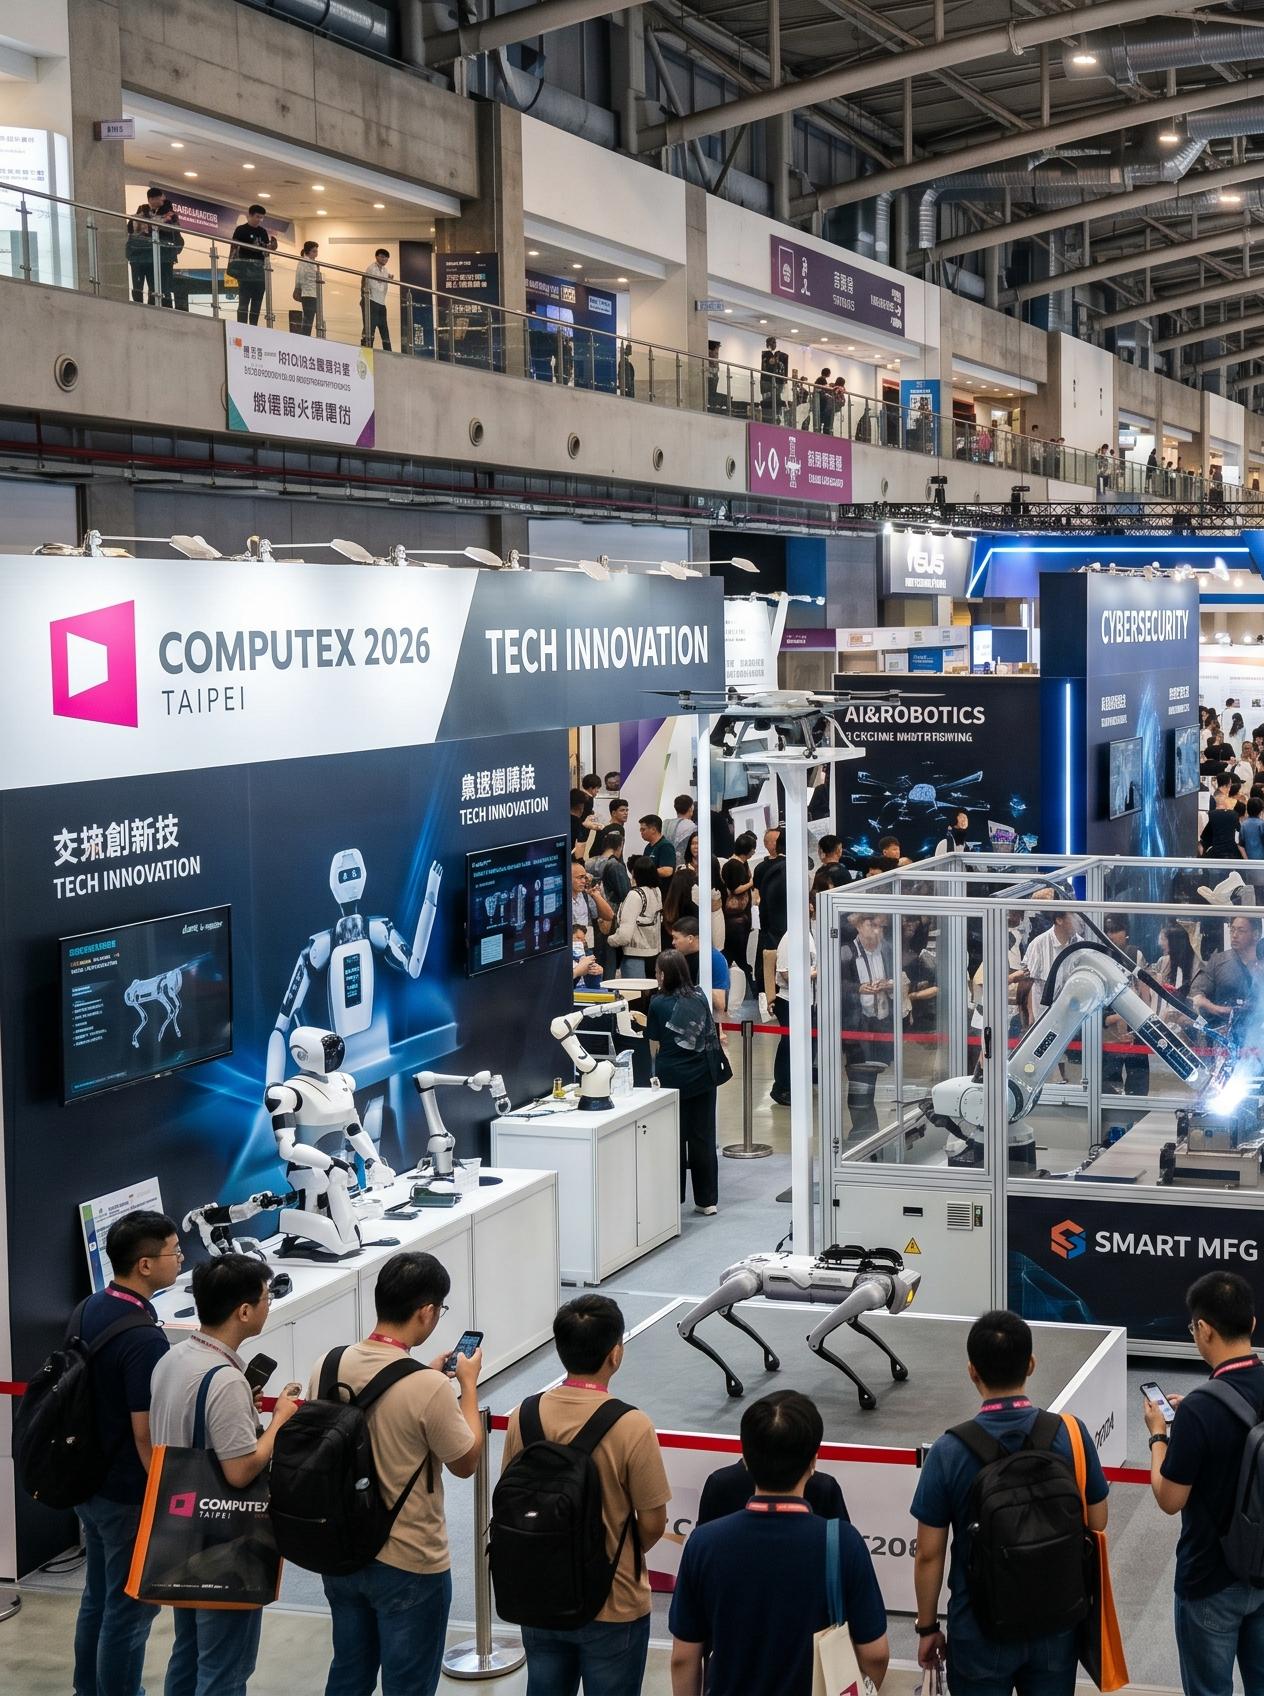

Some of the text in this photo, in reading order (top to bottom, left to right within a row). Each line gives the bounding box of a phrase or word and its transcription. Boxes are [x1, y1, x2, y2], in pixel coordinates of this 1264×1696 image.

[1101, 609, 1189, 645] CYBERSECURITY
[158, 626, 431, 675] COMPUTEX 2026
[485, 628, 558, 675] TECH
[566, 625, 709, 671] INNOVATION
[161, 686, 245, 715] TAIPEI
[845, 706, 986, 725] AI&ROBOTICS
[459, 796, 549, 826] TECH INNOVATION
[53, 855, 201, 899] TECH INNOVATION
[1095, 1231, 1258, 1262] SMART MFG
